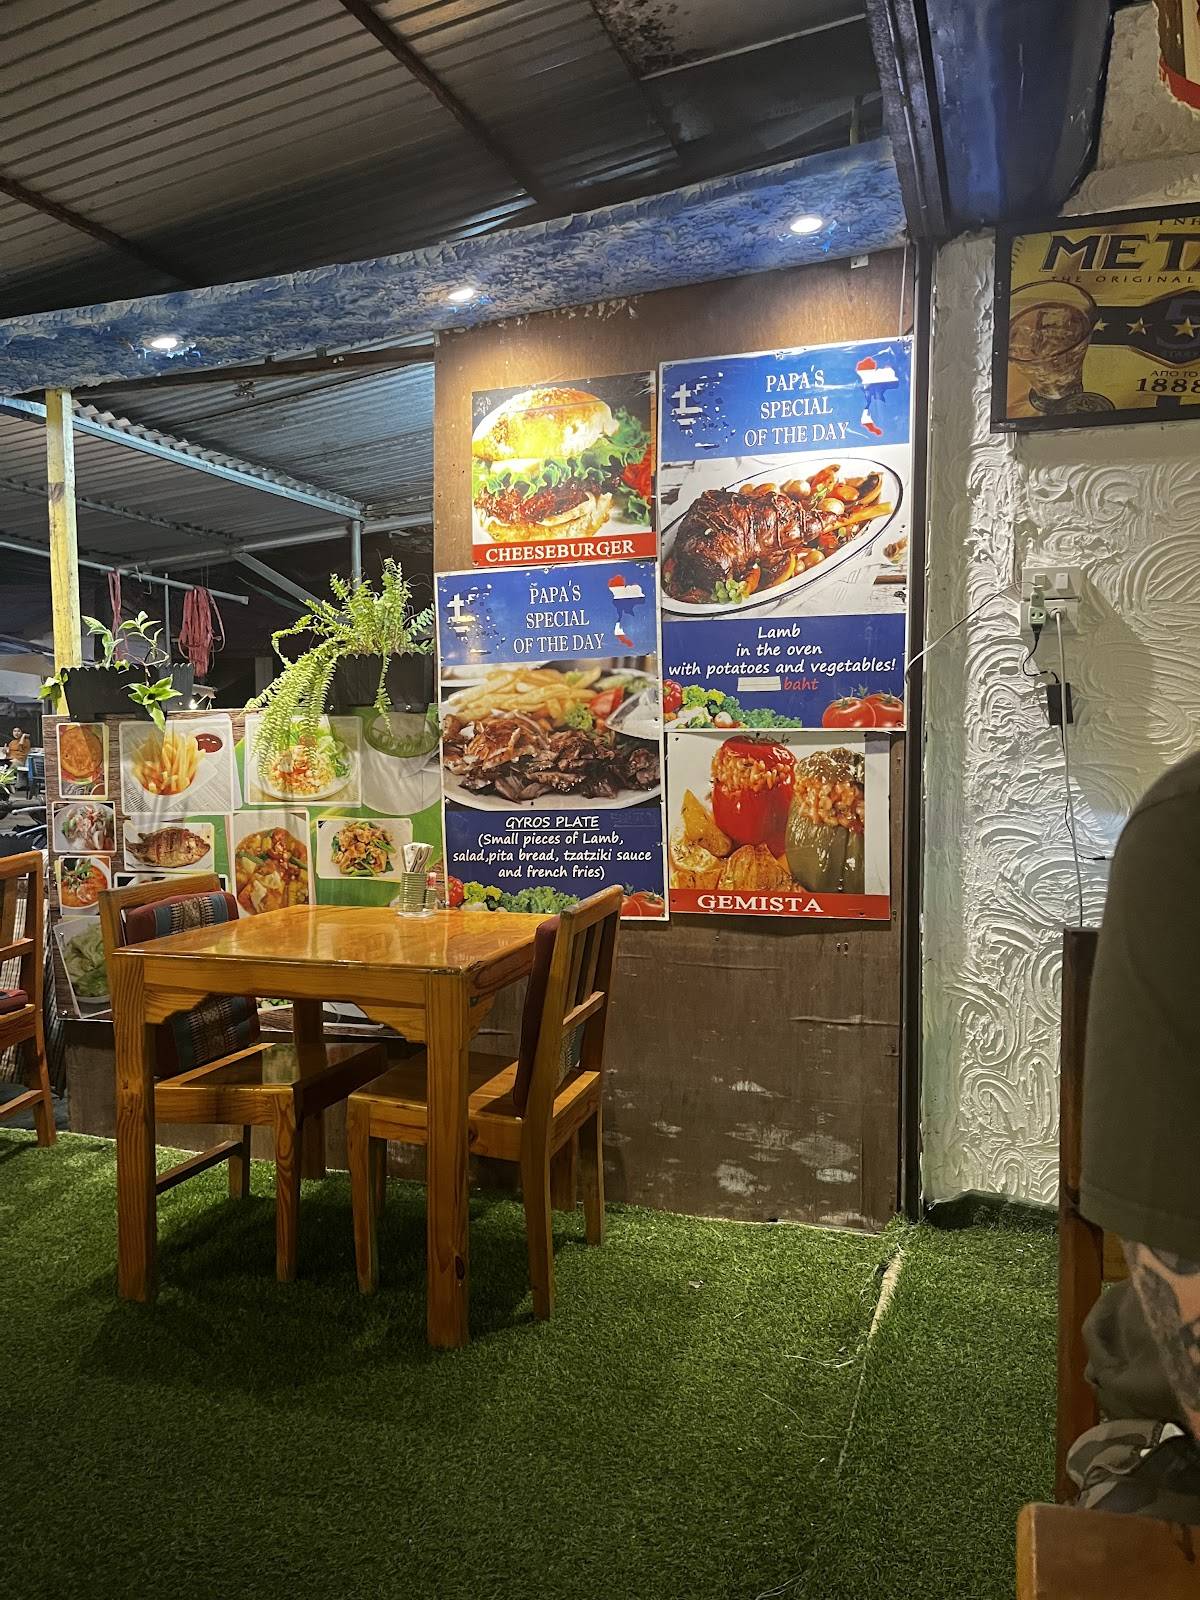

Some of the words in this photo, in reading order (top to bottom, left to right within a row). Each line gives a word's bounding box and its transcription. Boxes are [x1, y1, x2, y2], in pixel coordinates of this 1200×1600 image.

[1039, 232, 1200, 272] MET
[1095, 275, 1195, 285] ORIGINAL
[765, 364, 825, 393] PAPA'S
[760, 396, 834, 420] SPECIAL
[744, 428, 769, 447] OF
[772, 425, 808, 445] THE
[812, 421, 849, 442] DAY
[485, 539, 636, 563] CHEESEBURGER
[529, 579, 582, 605] PAPA'S
[526, 609, 590, 630] SPECIAL
[757, 623, 801, 640] Lamb
[513, 637, 534, 654] OF
[537, 635, 569, 653] THE
[572, 632, 605, 651] DAY
[736, 644, 751, 657] in
[757, 643, 781, 657] the
[787, 644, 823, 656] oven
[668, 662, 701, 676] with
[705, 660, 770, 679] potatoes
[775, 659, 805, 673] and
[811, 657, 897, 677] vegetables!
[783, 677, 819, 691] baht
[505, 816, 551, 830] GYROS
[556, 815, 600, 829] PLATE
[478, 833, 519, 848] (Small
[523, 832, 561, 849] pieces
[565, 832, 579, 845] of
[583, 831, 624, 846] Lamb,
[453, 849, 514, 865] salad,pita
[518, 849, 559, 862] bread,
[563, 848, 612, 861] tzatziki
[616, 850, 652, 861] sauce
[498, 866, 522, 878] and
[526, 865, 568, 879] french
[572, 865, 605, 880] fries)
[697, 894, 824, 913] GEMISTA
